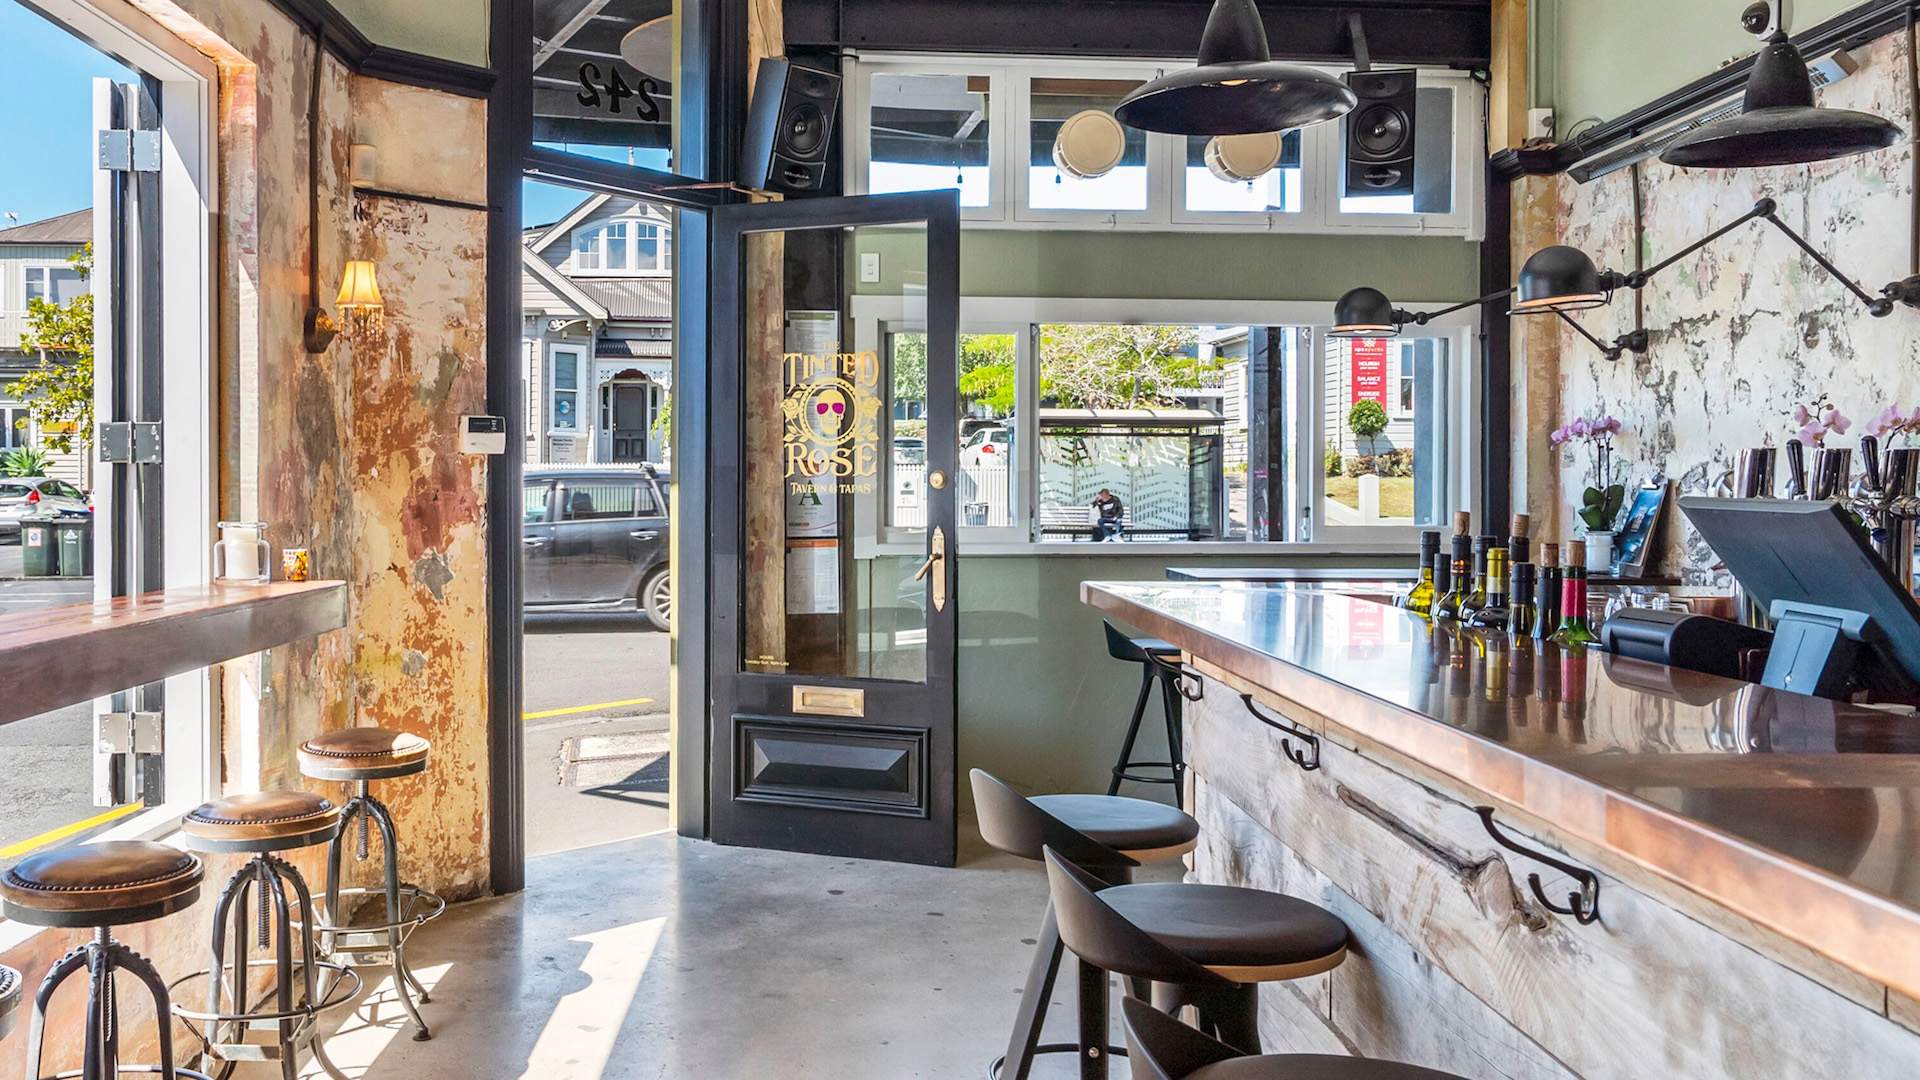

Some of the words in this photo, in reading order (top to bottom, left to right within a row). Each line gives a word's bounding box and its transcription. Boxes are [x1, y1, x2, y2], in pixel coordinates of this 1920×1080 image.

[783, 351, 880, 394] TINTED
[784, 442, 877, 478] ROSE
[790, 482, 828, 496] TAVERN
[839, 482, 872, 495] TAPAS
[798, 480, 823, 505] A
